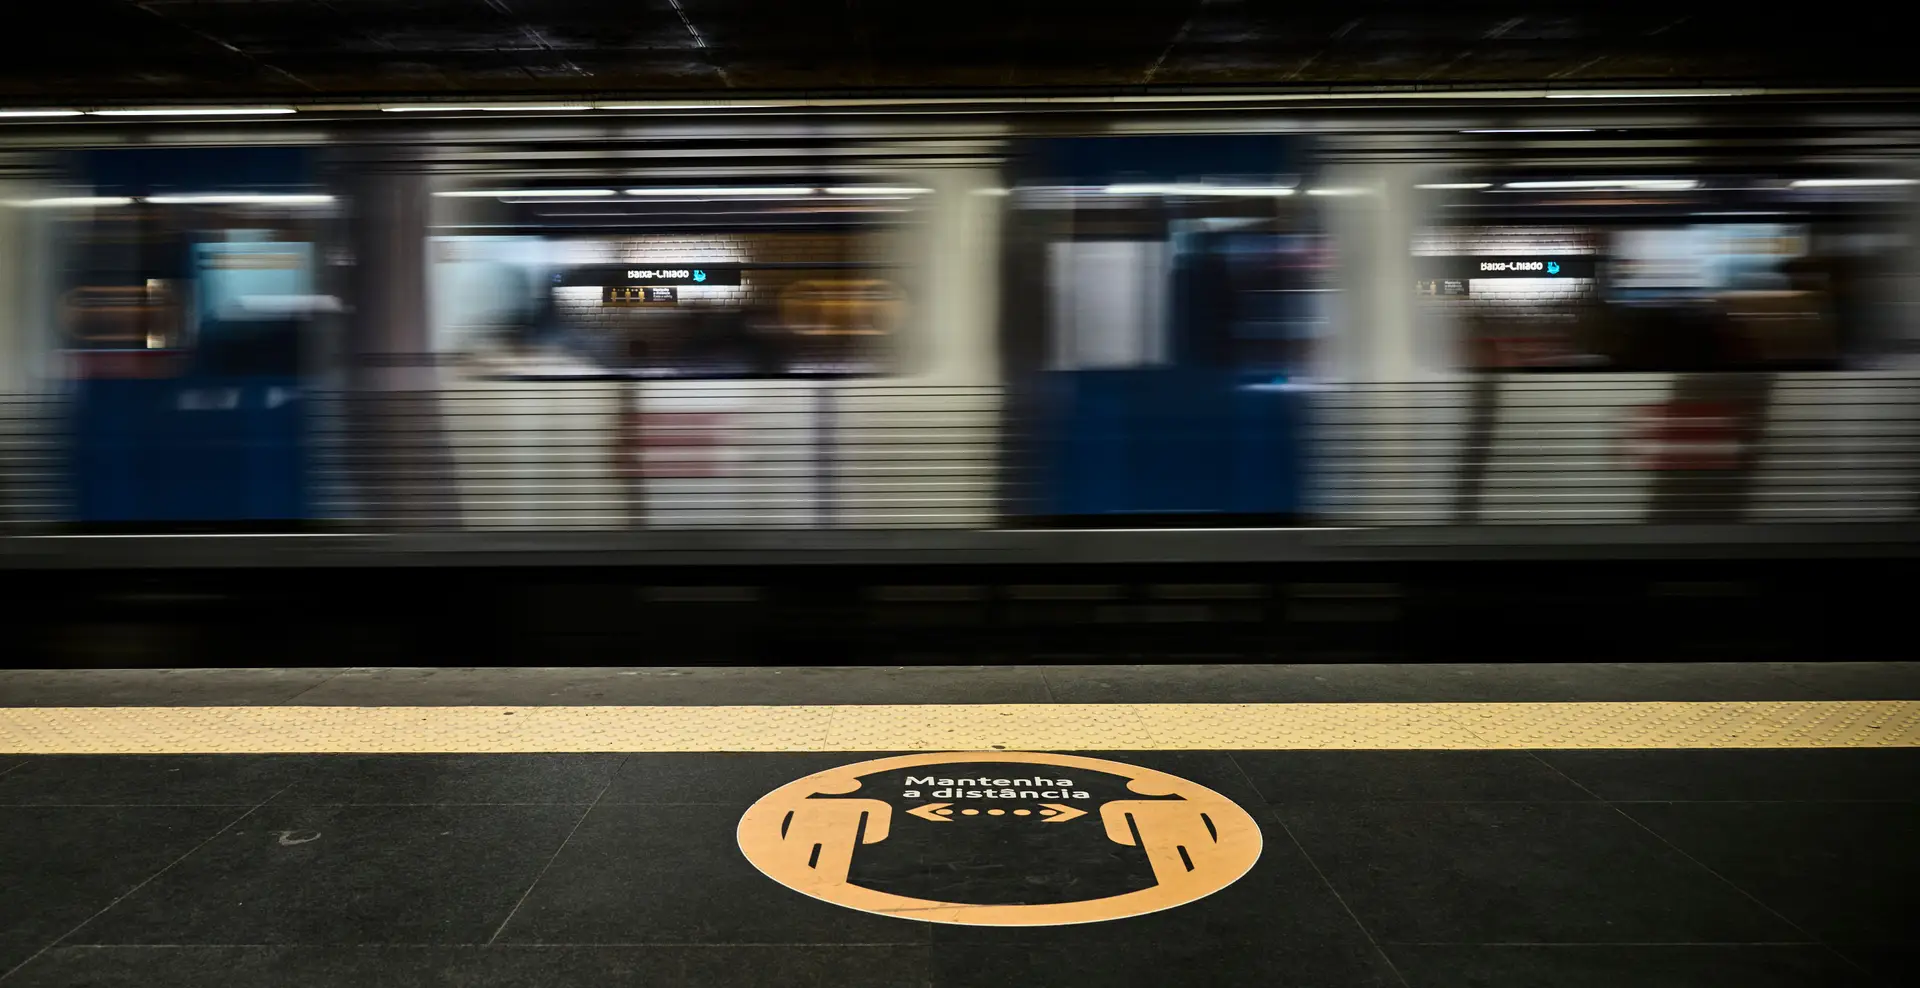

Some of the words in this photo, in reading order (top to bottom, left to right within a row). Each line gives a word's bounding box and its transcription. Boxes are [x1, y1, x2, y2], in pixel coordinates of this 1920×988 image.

[904, 776, 1074, 787] Mantenha
[902, 789, 921, 798] a
[932, 788, 1090, 799] distância
